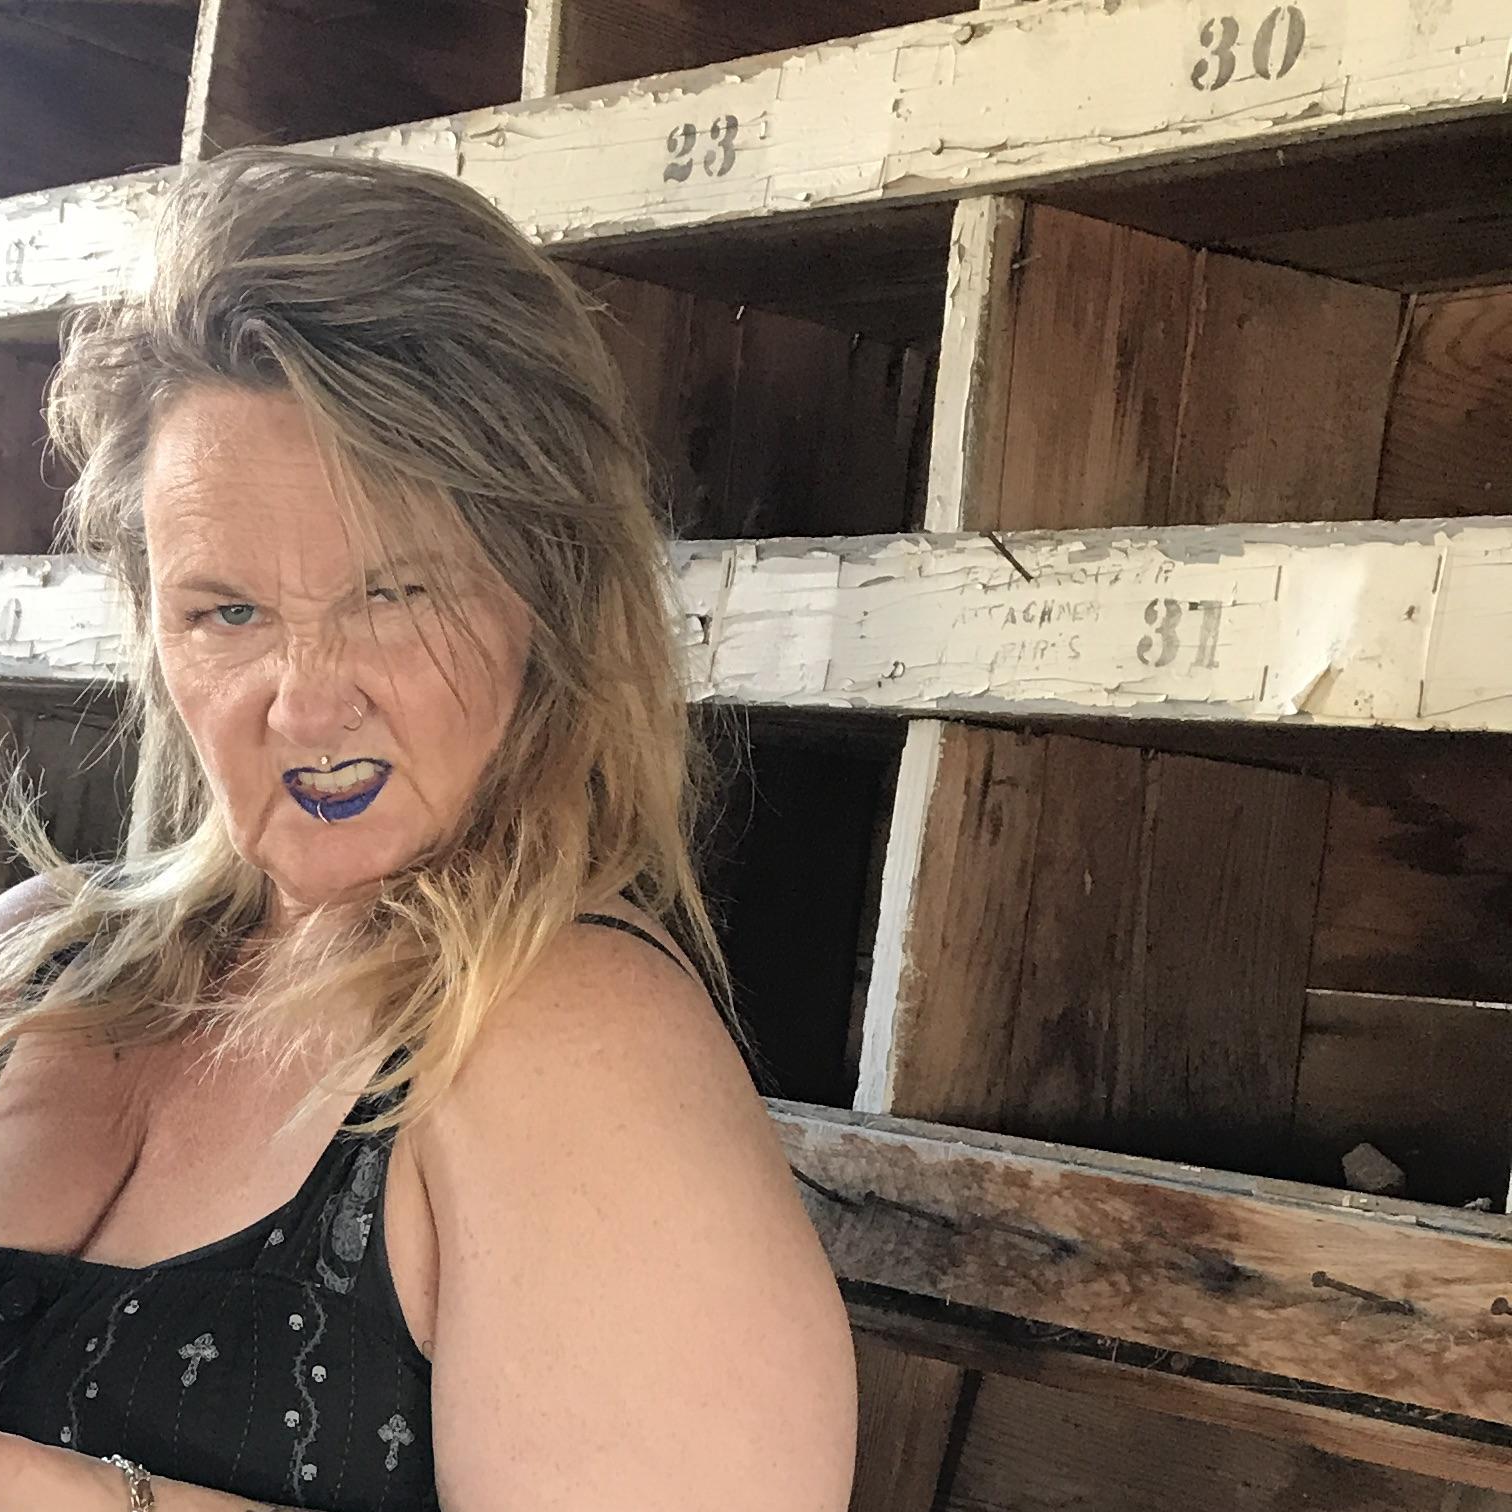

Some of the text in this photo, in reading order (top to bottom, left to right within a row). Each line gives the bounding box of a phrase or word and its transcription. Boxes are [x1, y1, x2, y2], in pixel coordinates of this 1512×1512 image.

[1190, 5, 1307, 92] 30
[663, 114, 739, 184] 23
[1136, 597, 1222, 669] 31
